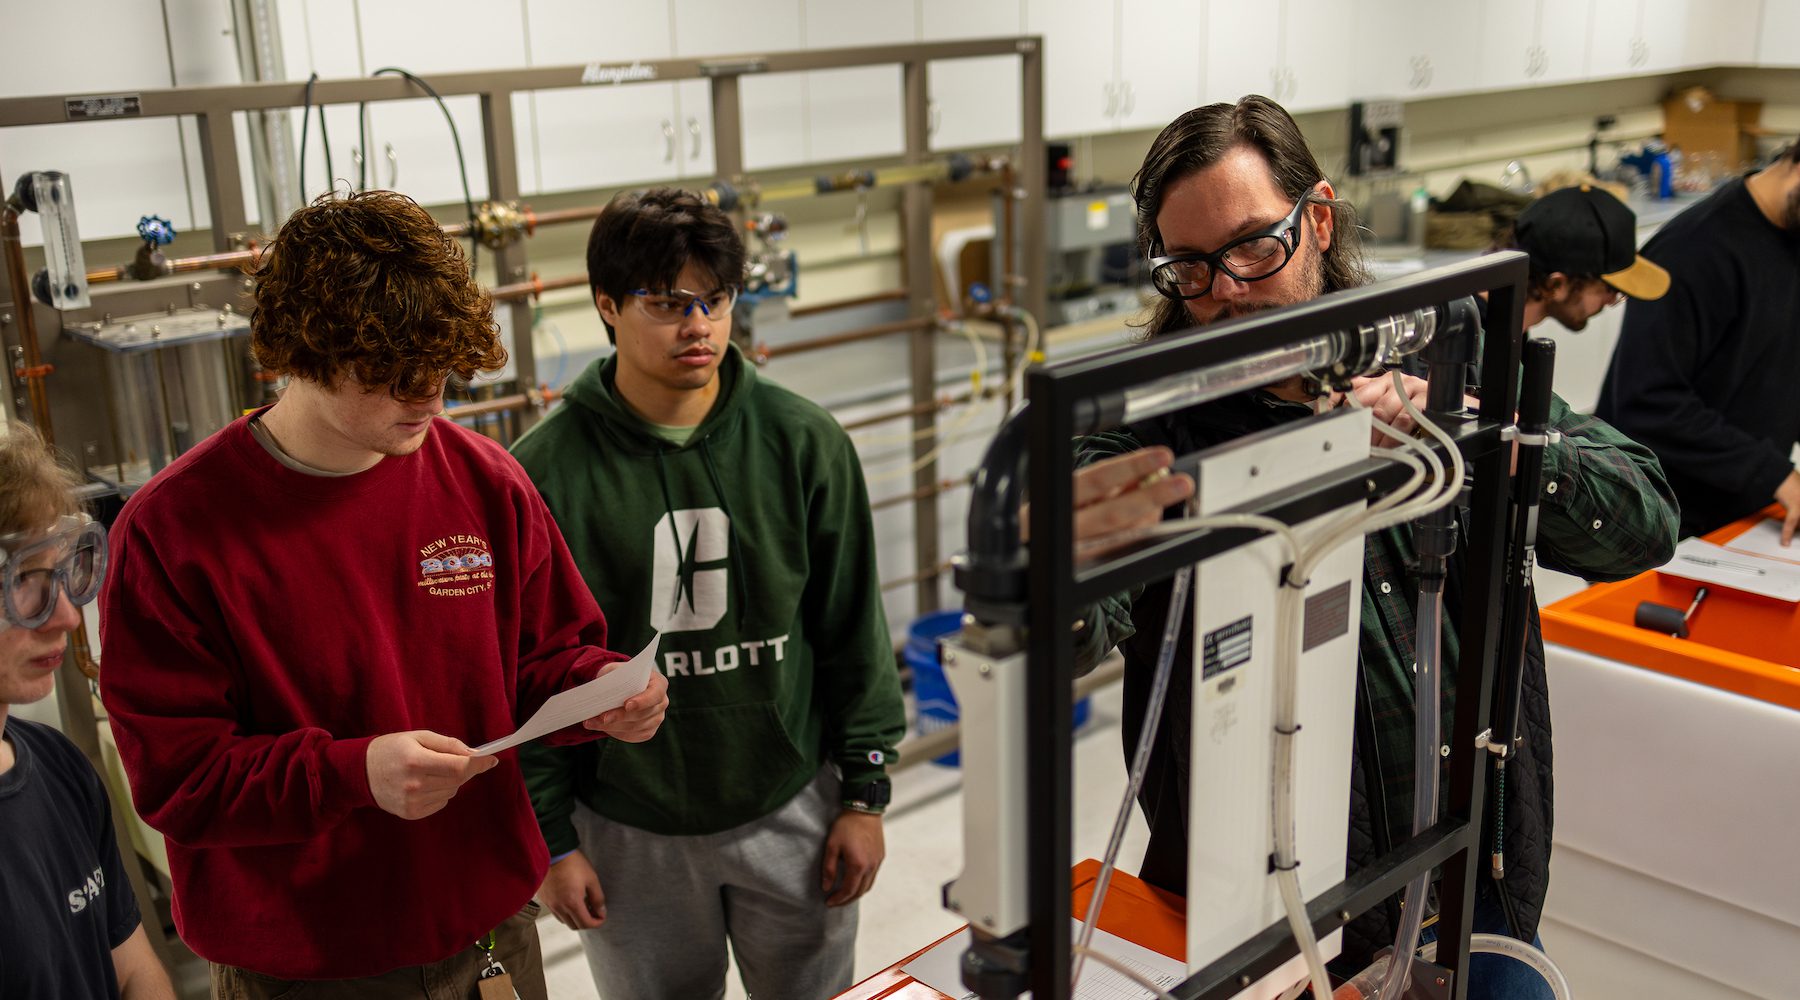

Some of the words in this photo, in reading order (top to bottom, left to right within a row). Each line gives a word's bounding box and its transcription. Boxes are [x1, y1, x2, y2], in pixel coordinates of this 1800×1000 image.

[420, 538, 447, 557] NEW
[449, 535, 487, 550] YEAR'S
[420, 552, 492, 575] 2000
[429, 587, 465, 596] GARDEN
[467, 584, 486, 595] CITY,
[486, 580, 492, 590] S
[655, 634, 789, 678] RLOTT
